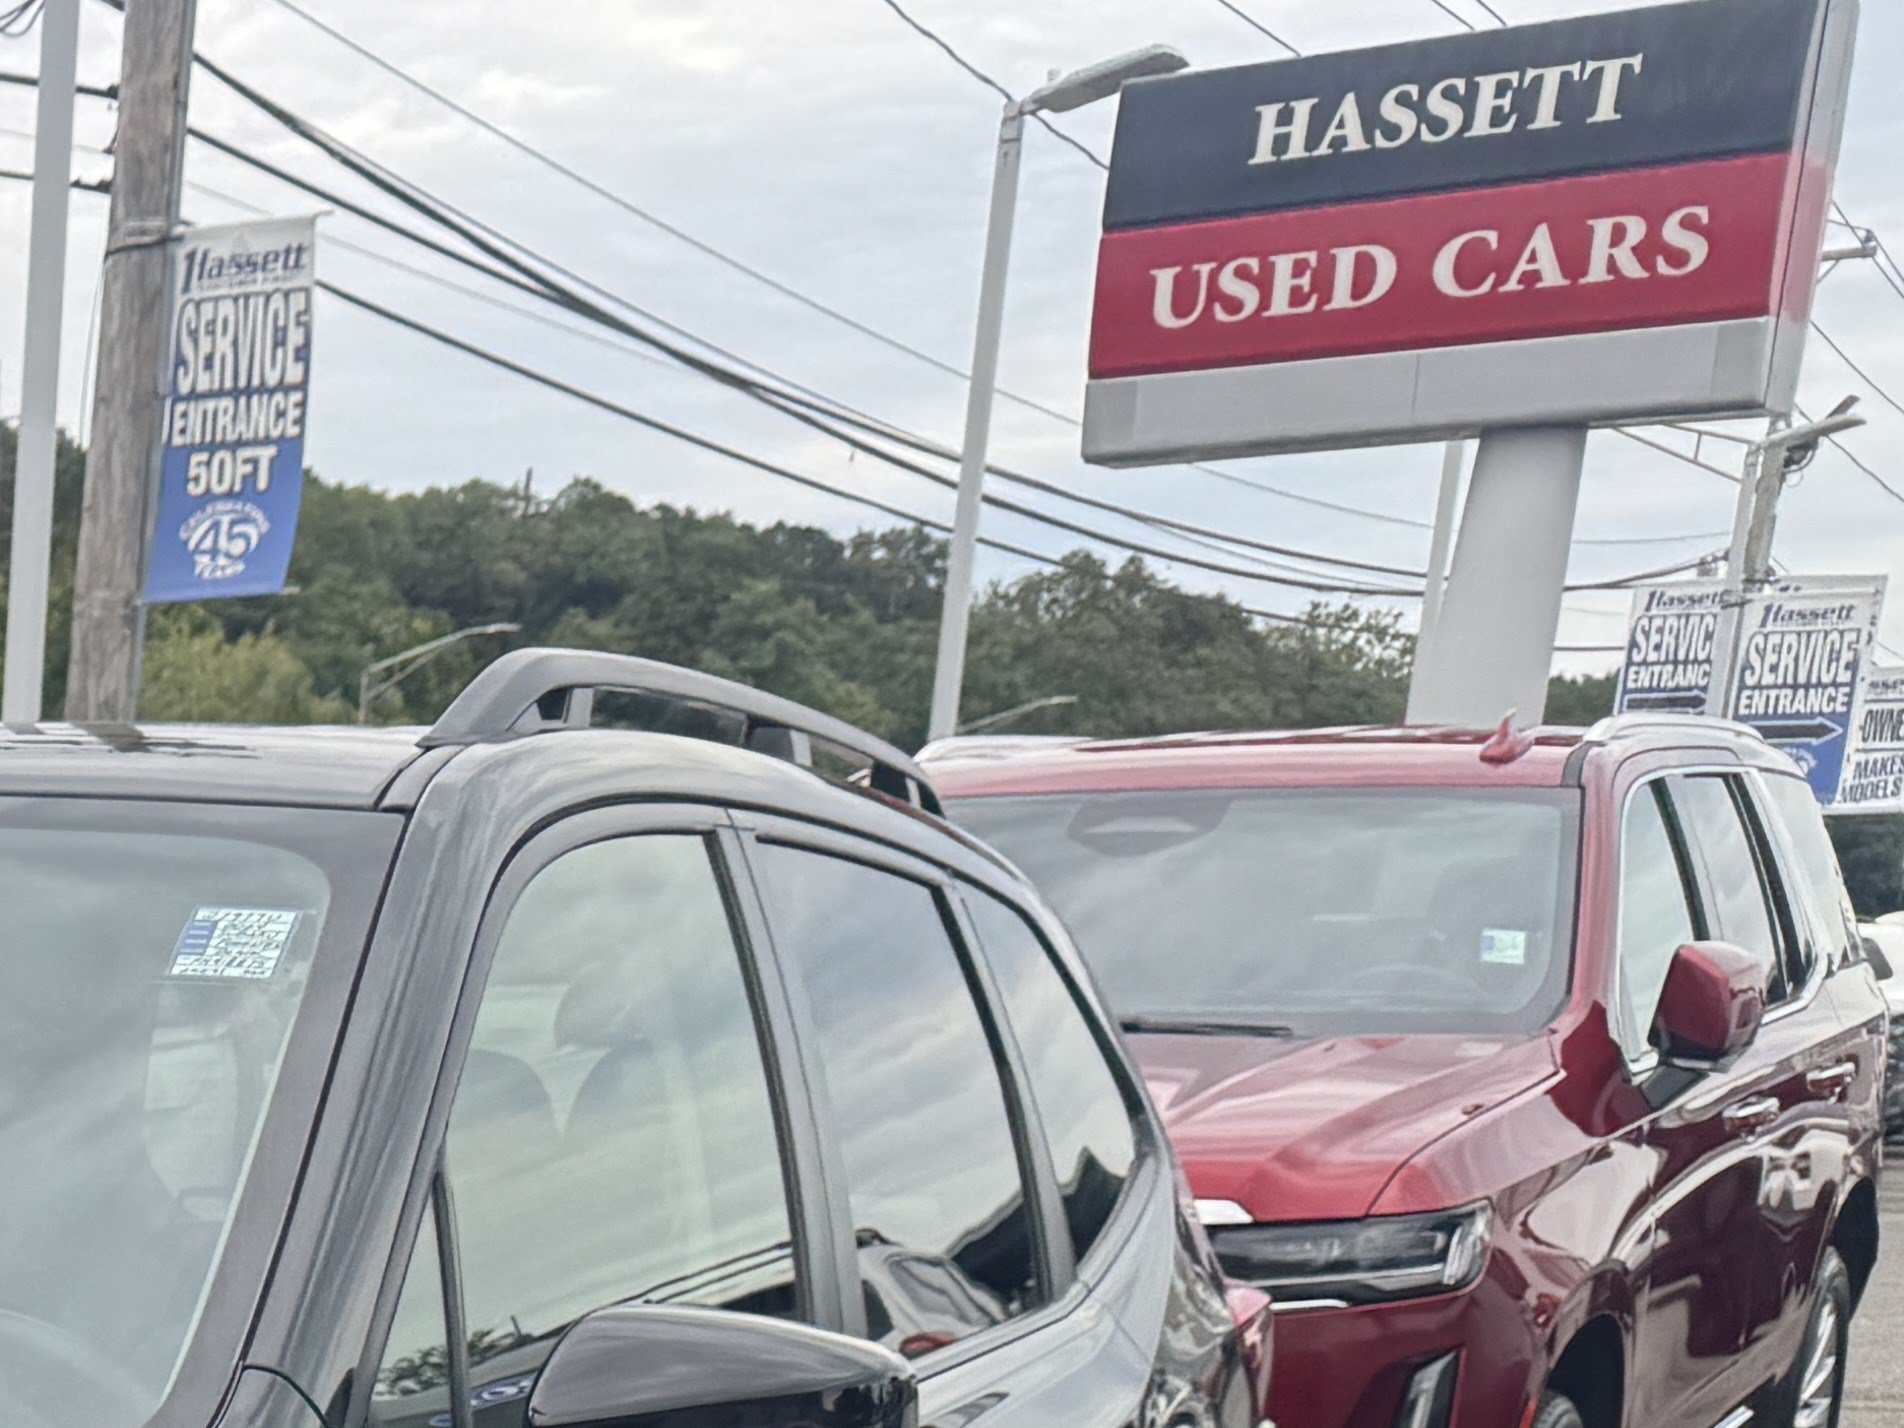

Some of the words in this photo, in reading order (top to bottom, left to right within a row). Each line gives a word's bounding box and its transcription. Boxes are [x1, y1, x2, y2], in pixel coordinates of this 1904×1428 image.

[1248, 52, 1643, 165] HASSETT
[182, 242, 309, 295] Hassett
[1149, 243, 1398, 329] USED
[1432, 206, 1711, 298] CARS
[176, 289, 310, 396] SERVICE
[171, 391, 303, 446] ENTRANCE
[187, 444, 279, 497] 50FT
[1632, 614, 1715, 663] SERVIC
[1744, 629, 1859, 687] SERVICE
[1627, 662, 1711, 689] ENTRANC
[1738, 686, 1851, 715] ENTRANCE
